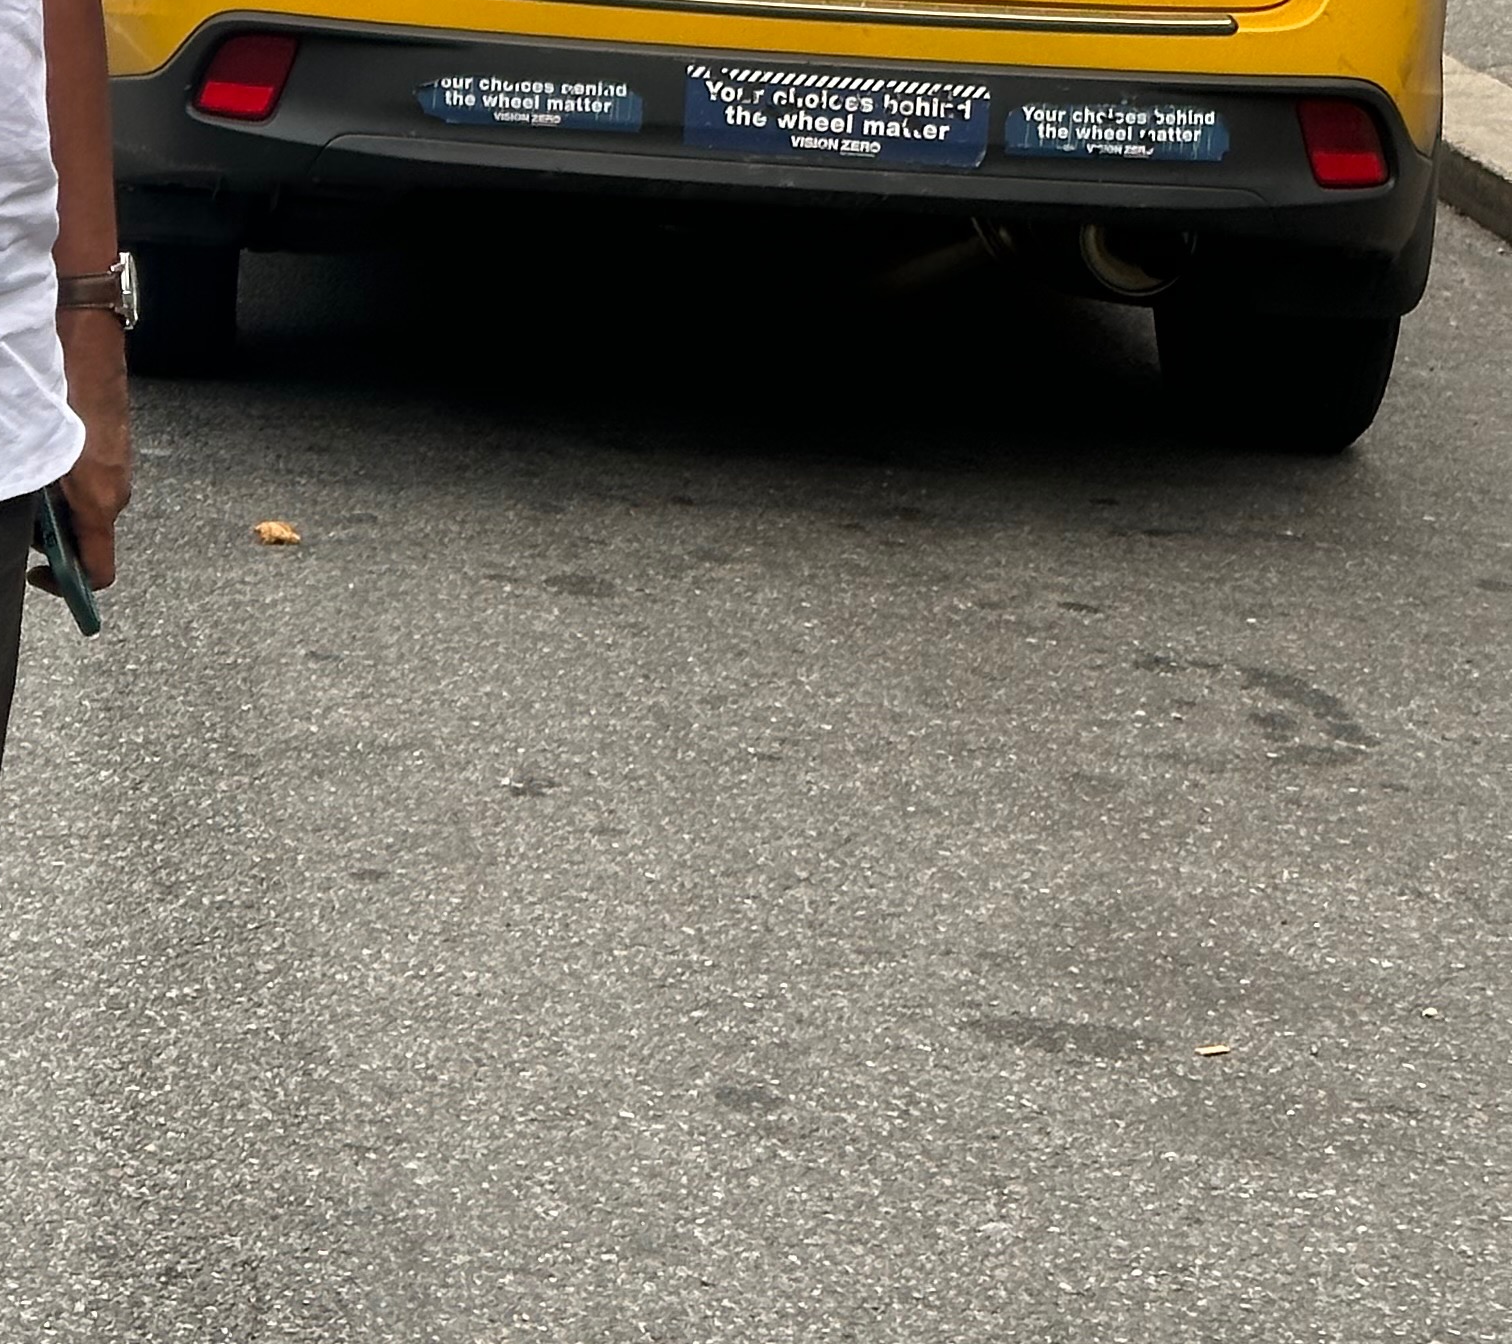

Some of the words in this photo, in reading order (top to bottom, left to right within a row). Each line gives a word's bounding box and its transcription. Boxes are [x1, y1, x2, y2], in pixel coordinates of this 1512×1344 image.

[435, 75, 473, 90] our
[445, 90, 476, 107] the
[482, 92, 539, 110] wheel
[546, 96, 612, 113] matter
[493, 111, 530, 123] VISION
[532, 114, 561, 124] ZERO
[725, 106, 767, 127] the
[778, 111, 853, 134] wheel
[1022, 106, 1066, 122] Your
[1037, 123, 1069, 139] the
[1076, 124, 1133, 141] wheel
[791, 135, 839, 151] VISION
[840, 139, 881, 153] ZERO
